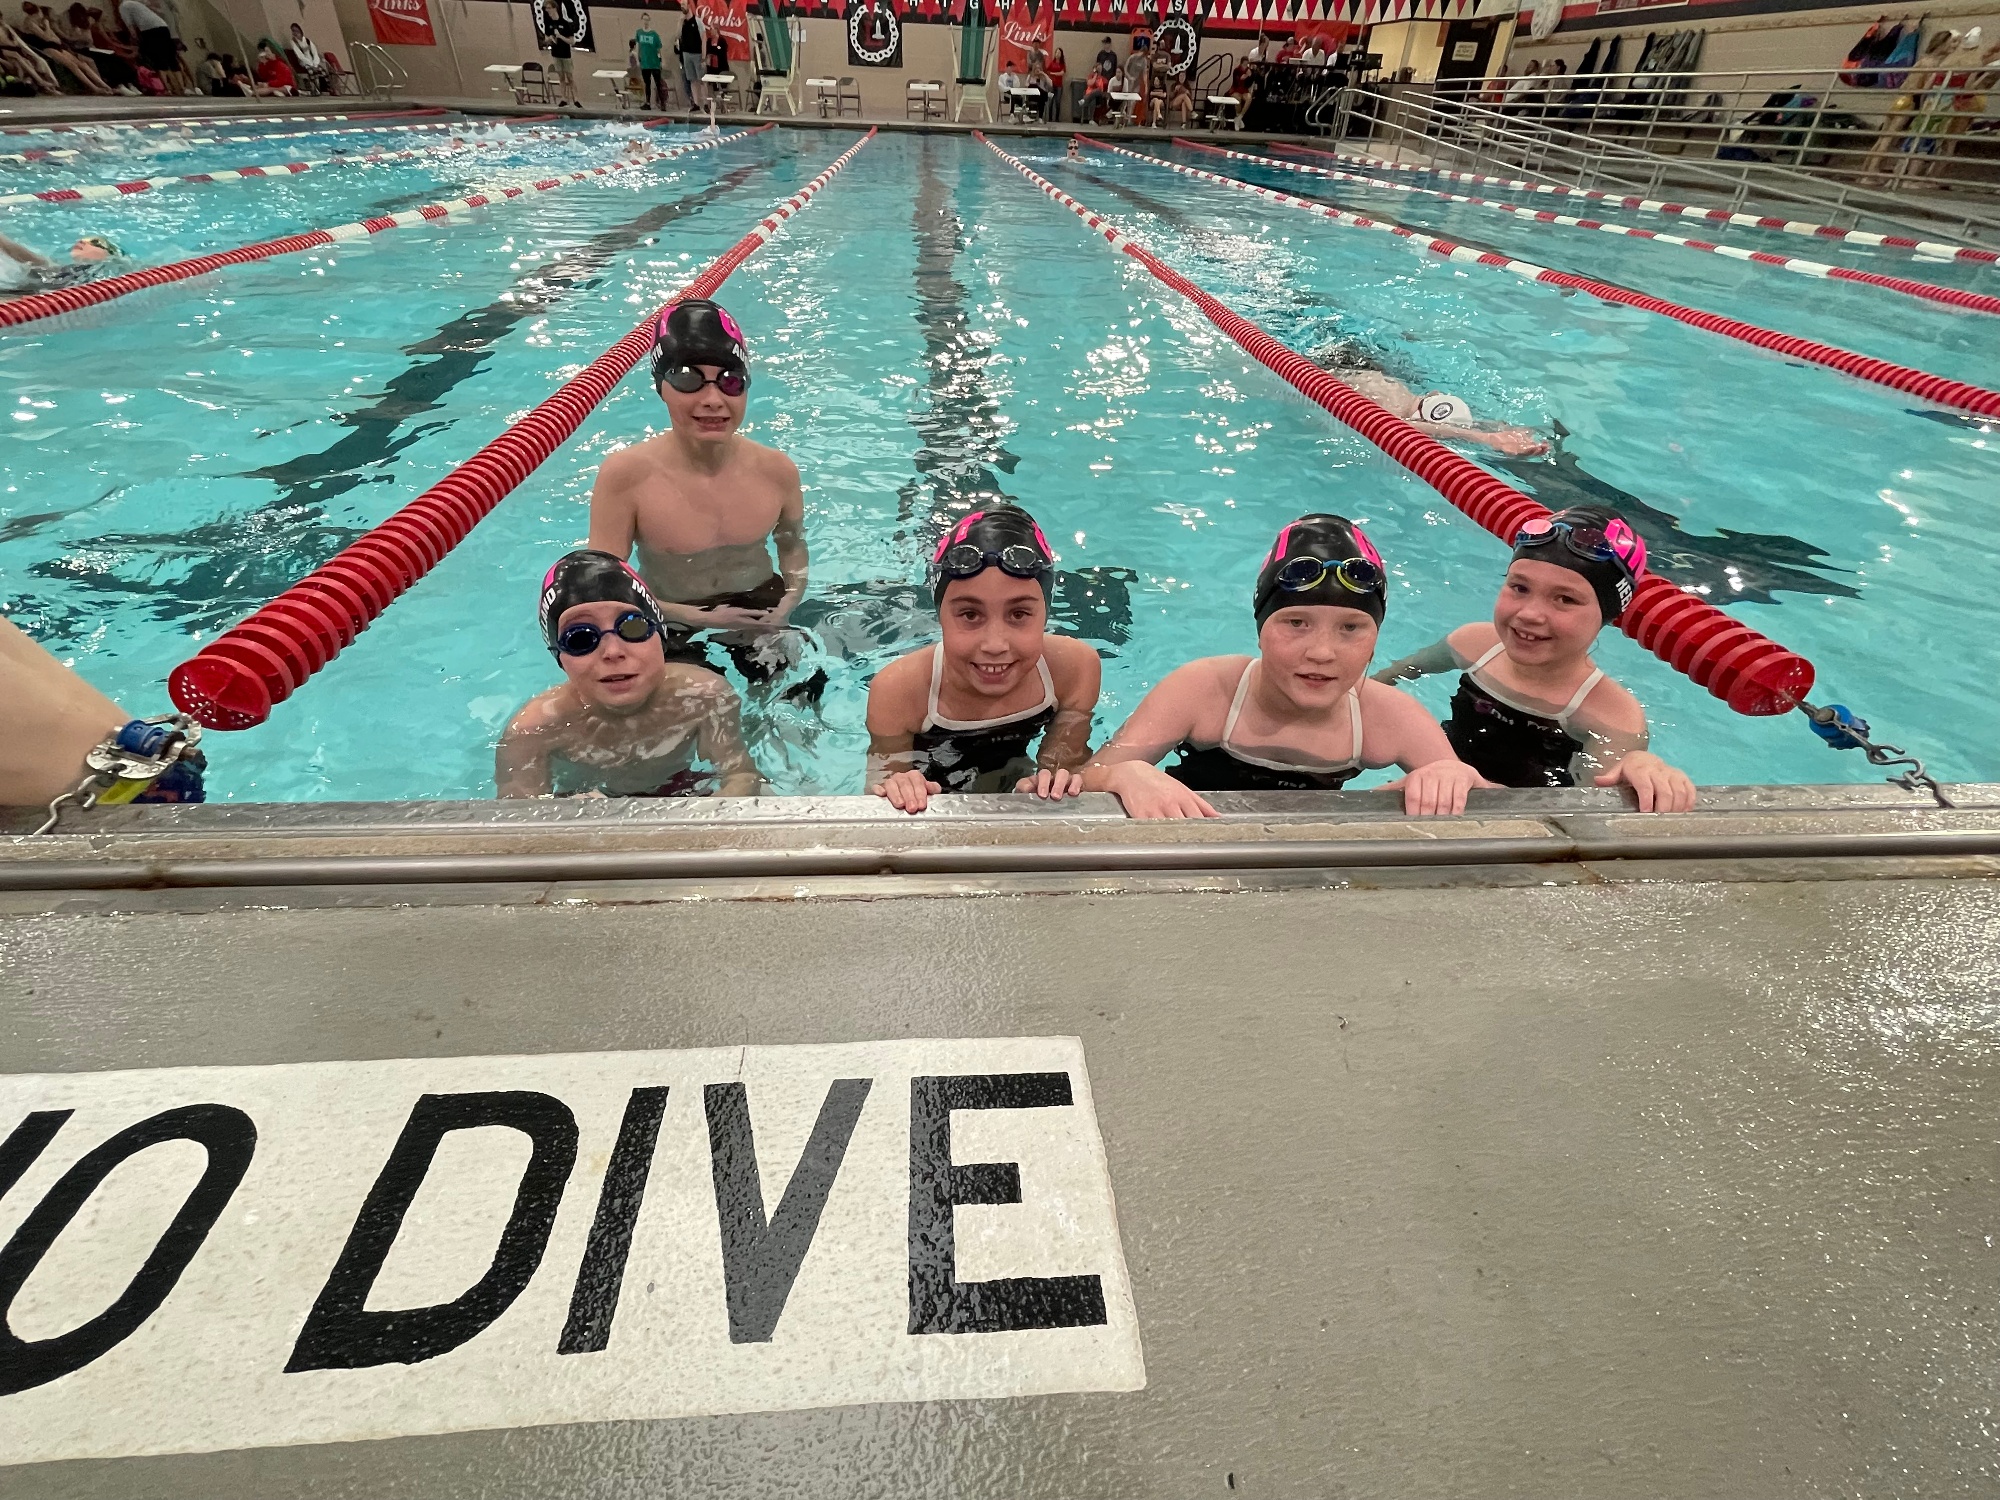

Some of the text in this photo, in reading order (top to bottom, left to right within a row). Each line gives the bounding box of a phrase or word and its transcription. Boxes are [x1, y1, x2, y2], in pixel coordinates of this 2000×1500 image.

[695, 4, 745, 28] Links
[1001, 21, 1051, 42] Links
[0, 1071, 1108, 1396] O DIVE
